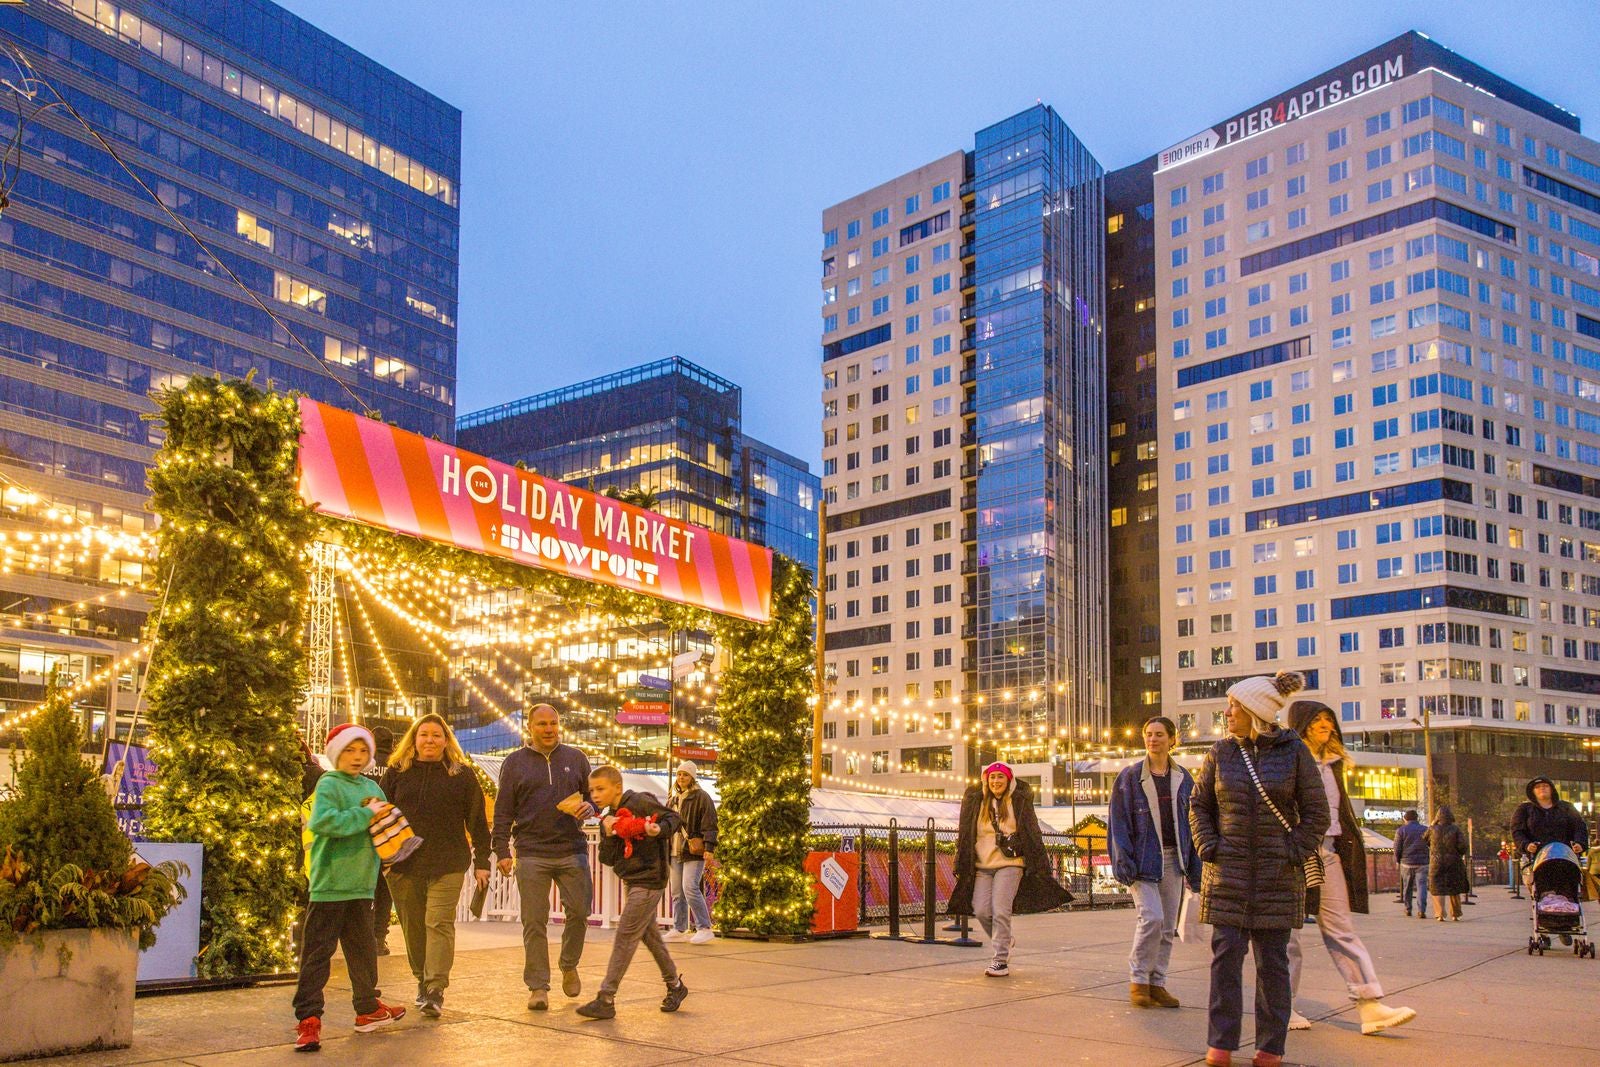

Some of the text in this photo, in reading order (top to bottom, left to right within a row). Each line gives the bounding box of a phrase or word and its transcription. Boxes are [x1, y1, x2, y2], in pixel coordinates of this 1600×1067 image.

[1226, 54, 1404, 144] PIER4APTS.COM
[1168, 137, 1210, 164] 100 PIER 4
[475, 480, 489, 489] THE
[442, 454, 695, 563] HOLIDAY MARKET
[501, 524, 659, 585] SNOWPORT
[133, 762, 159, 773] HOLIDA
[1080, 778, 1092, 790] 100
